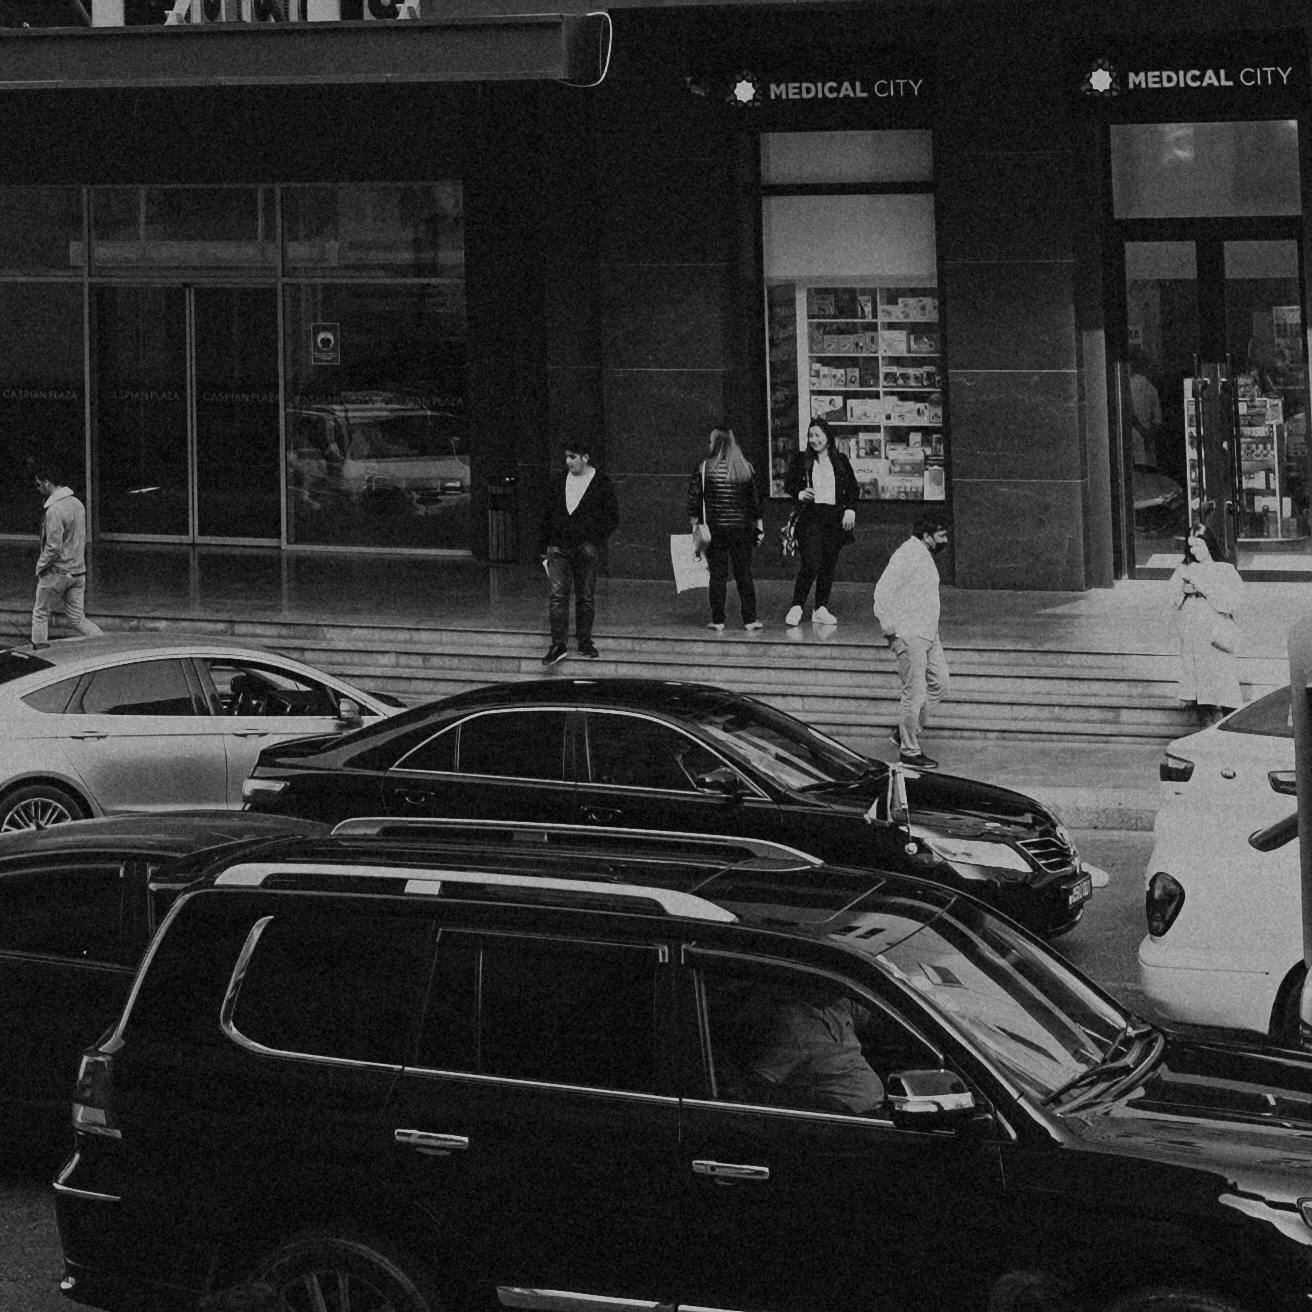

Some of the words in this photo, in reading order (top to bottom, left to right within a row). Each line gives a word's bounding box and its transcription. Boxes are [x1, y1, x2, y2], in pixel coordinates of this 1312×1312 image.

[769, 80, 868, 100] MEDICAL
[874, 78, 924, 97] CITY
[1128, 68, 1234, 90] MEDICAL
[1239, 66, 1293, 86] CITY
